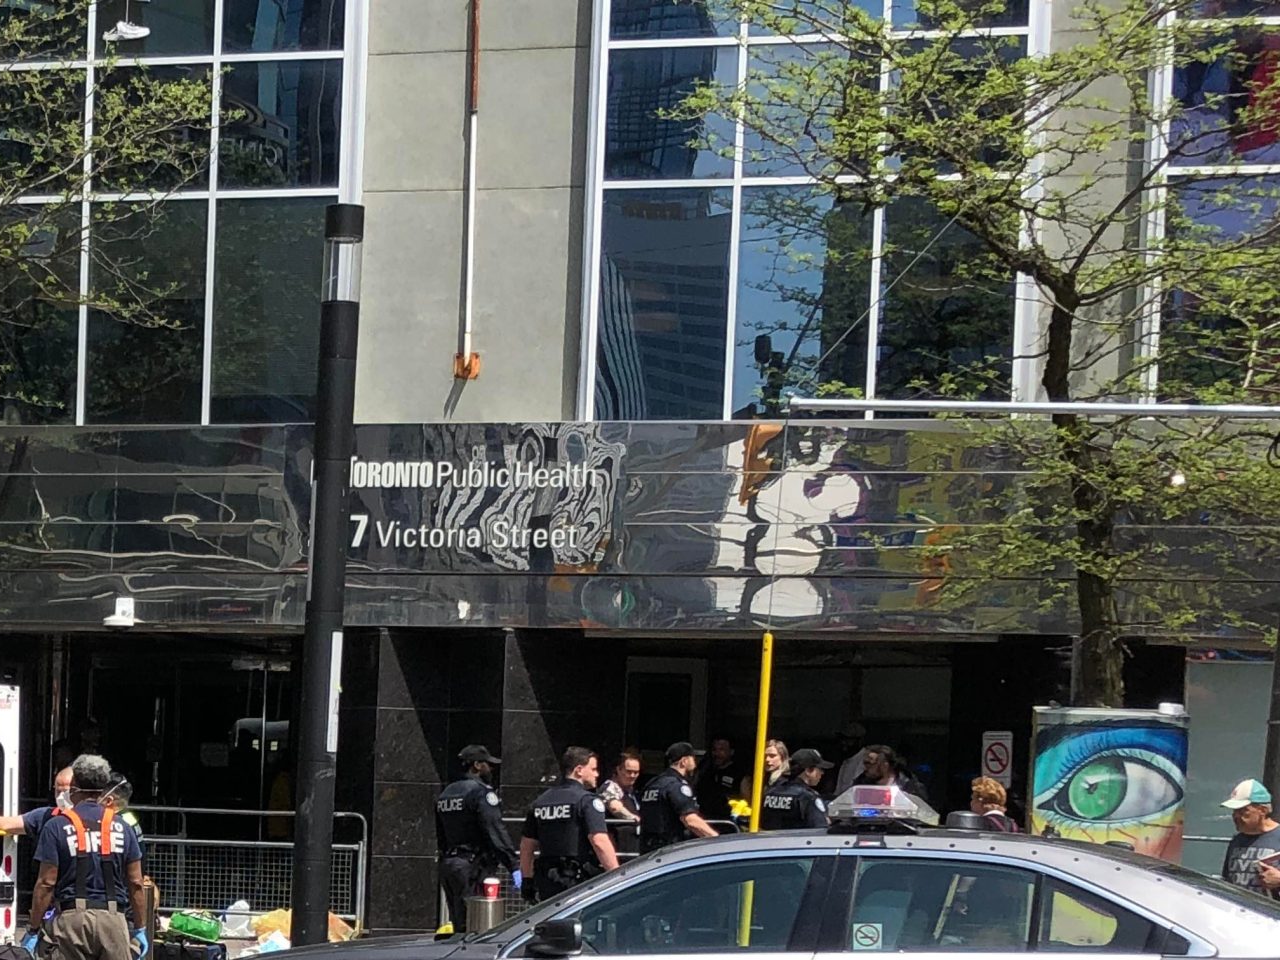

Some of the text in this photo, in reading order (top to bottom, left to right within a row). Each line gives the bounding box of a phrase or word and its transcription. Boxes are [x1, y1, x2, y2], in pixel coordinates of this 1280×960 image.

[436, 460, 510, 488] Public
[515, 460, 597, 488] Health
[376, 520, 481, 549] Victoria
[491, 520, 578, 549] Street
[436, 798, 463, 813] POLICE
[534, 805, 571, 820] POLICE
[763, 795, 793, 810] POLICE
[66, 831, 125, 857] FIRE
